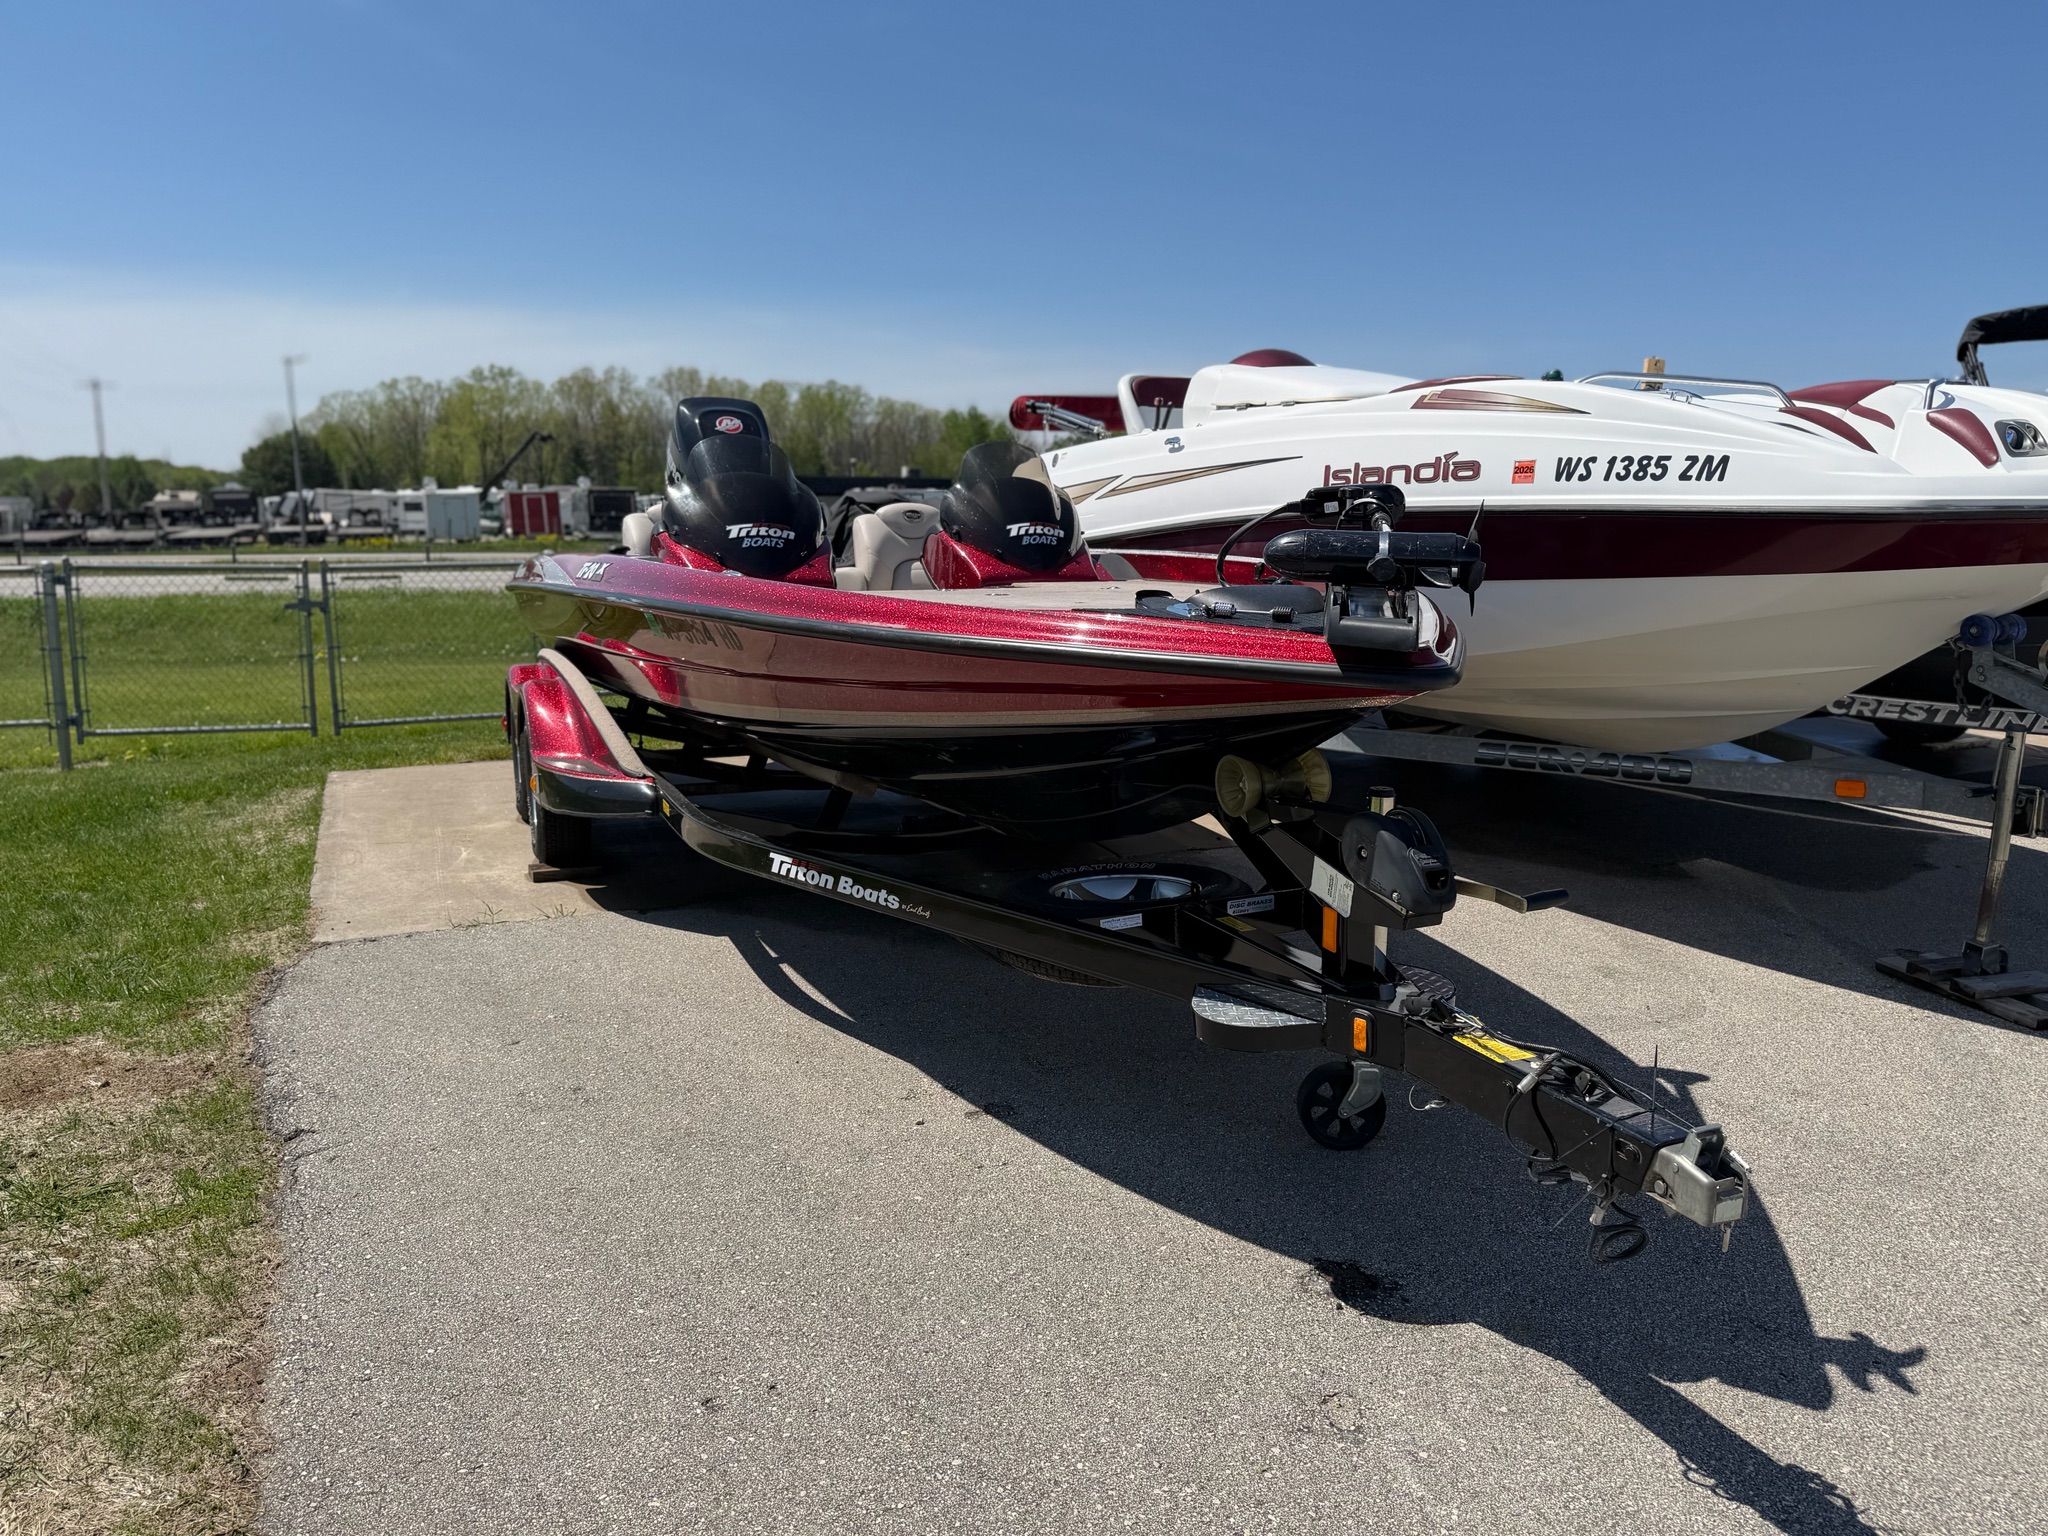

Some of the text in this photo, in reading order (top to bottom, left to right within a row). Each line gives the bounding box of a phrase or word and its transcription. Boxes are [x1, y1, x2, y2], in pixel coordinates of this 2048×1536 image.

[1514, 465, 1535, 475] 2026
[1554, 454, 1731, 483] WS 1385 ZM
[726, 523, 796, 540] Triton
[1006, 522, 1065, 538] Triton
[742, 537, 785, 548] BOATS
[1021, 534, 1058, 546] BOATS
[769, 852, 835, 890] Triton
[837, 875, 900, 910] Boats
